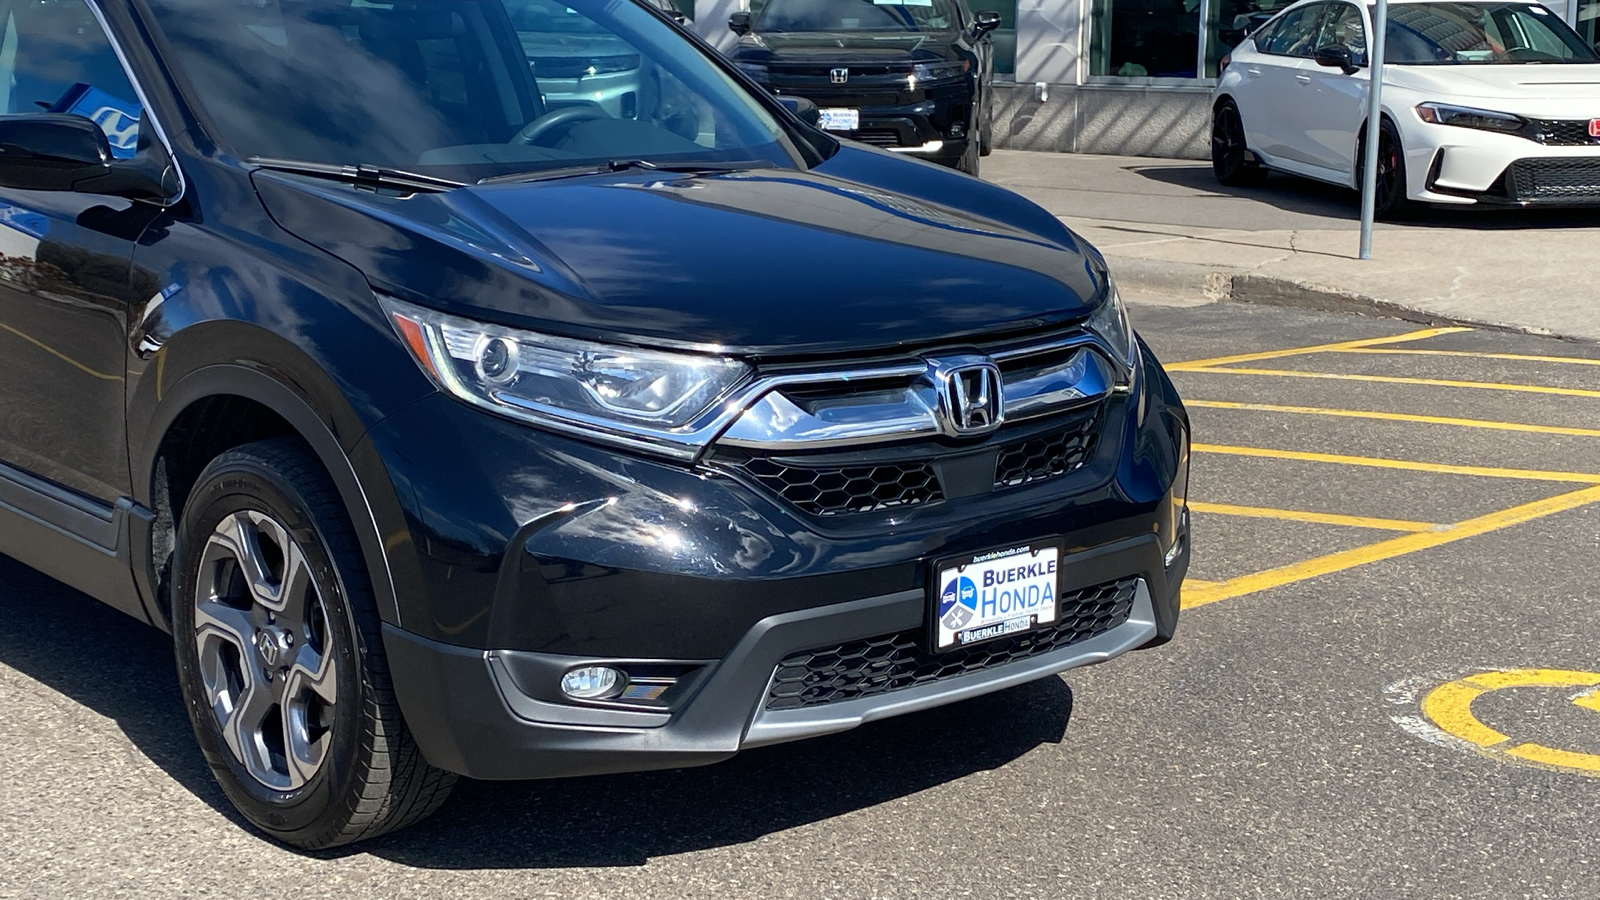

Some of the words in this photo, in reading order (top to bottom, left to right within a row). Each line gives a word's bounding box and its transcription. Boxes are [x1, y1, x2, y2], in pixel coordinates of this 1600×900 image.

[973, 546, 1030, 563] buerklehonda.com
[983, 560, 1056, 588] BUERKLE
[982, 582, 1054, 618] HONDA
[964, 624, 1004, 642] BUERKLE
[1004, 619, 1029, 632] HONDA
